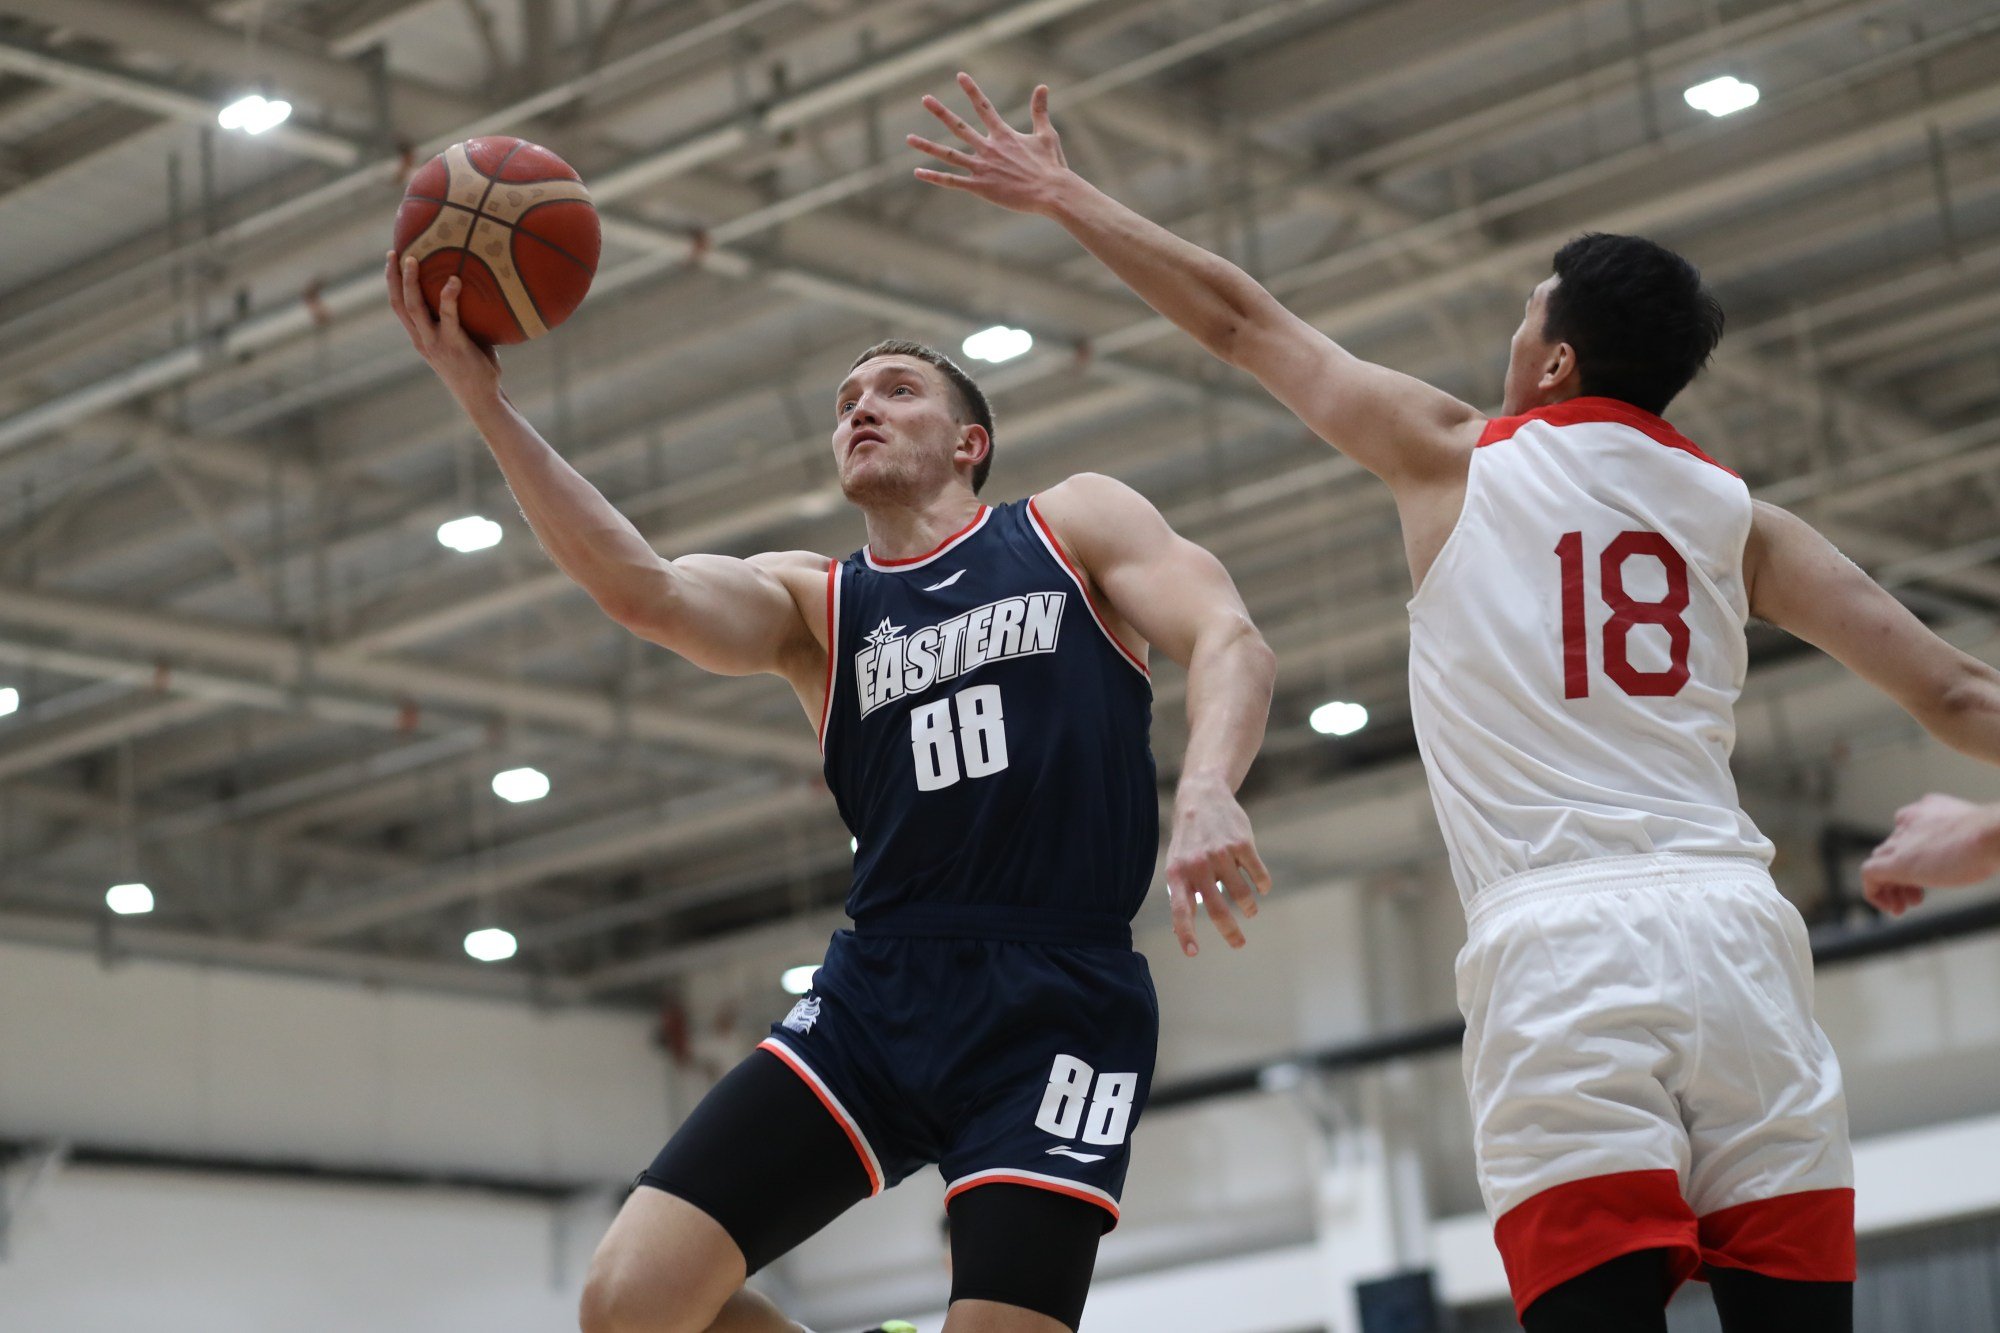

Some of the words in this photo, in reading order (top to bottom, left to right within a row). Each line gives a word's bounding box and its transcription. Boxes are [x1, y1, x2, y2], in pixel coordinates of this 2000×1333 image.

[855, 591, 1066, 720] EASTERN
[1554, 530, 1691, 699] 18
[910, 684, 1009, 791] 88
[1034, 1053, 1138, 1145] 88
